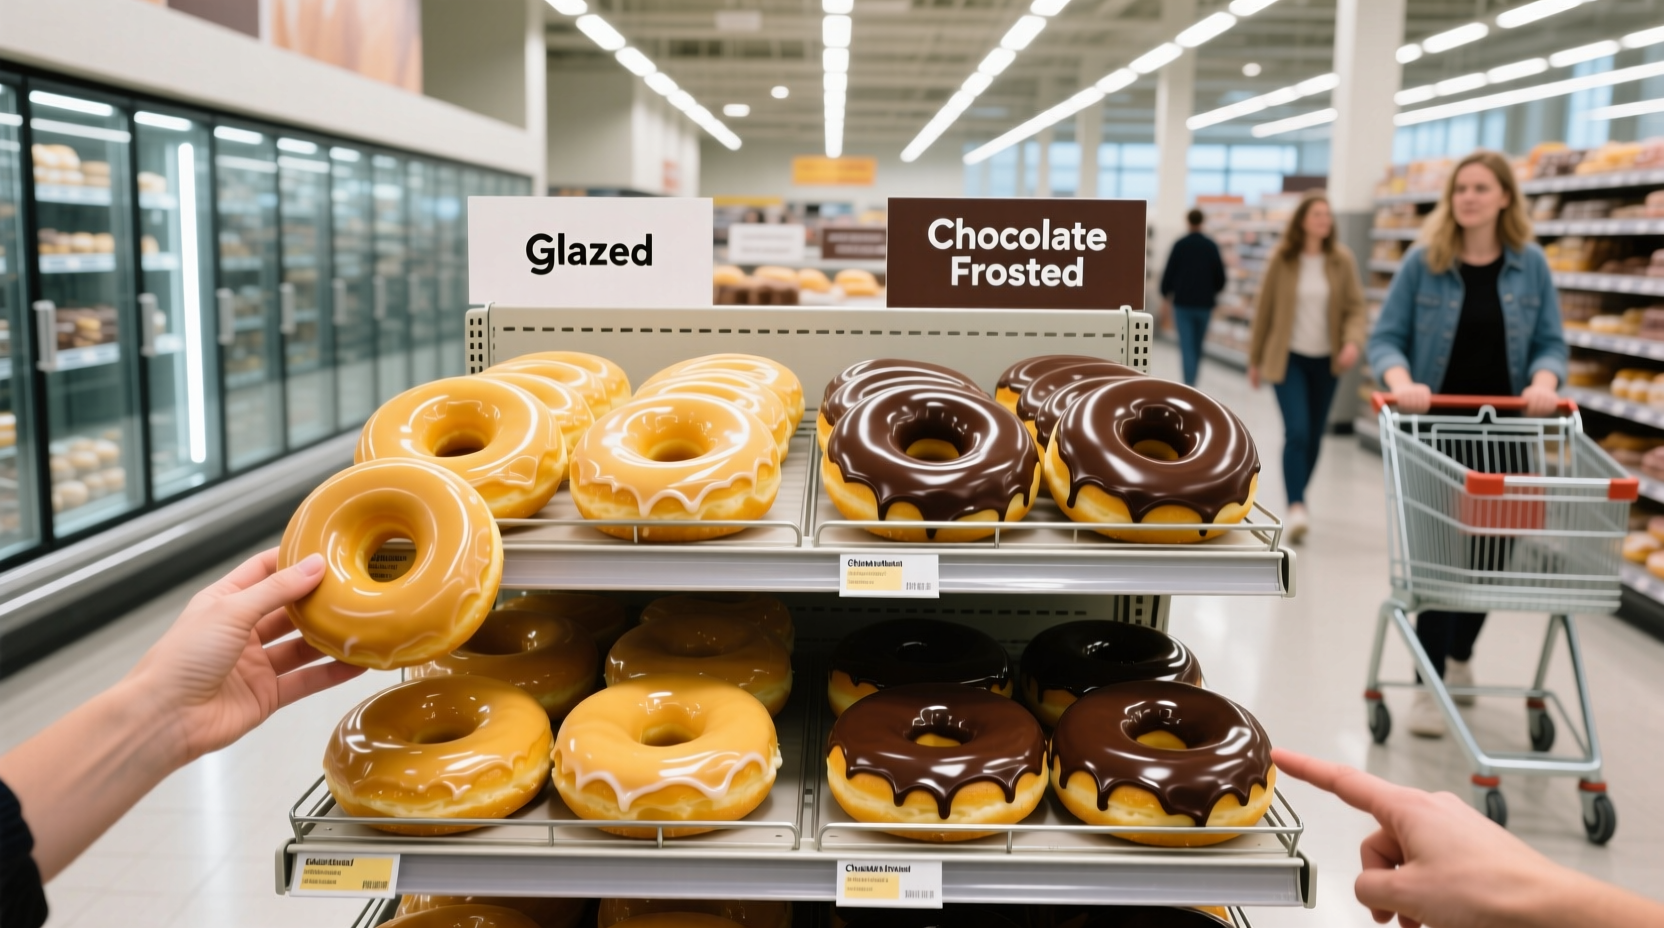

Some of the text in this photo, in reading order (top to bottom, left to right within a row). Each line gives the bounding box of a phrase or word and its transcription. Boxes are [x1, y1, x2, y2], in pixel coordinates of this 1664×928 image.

[927, 217, 1108, 252] Chocolate
[525, 232, 653, 276] Glazed
[951, 255, 1084, 288] Frosted
